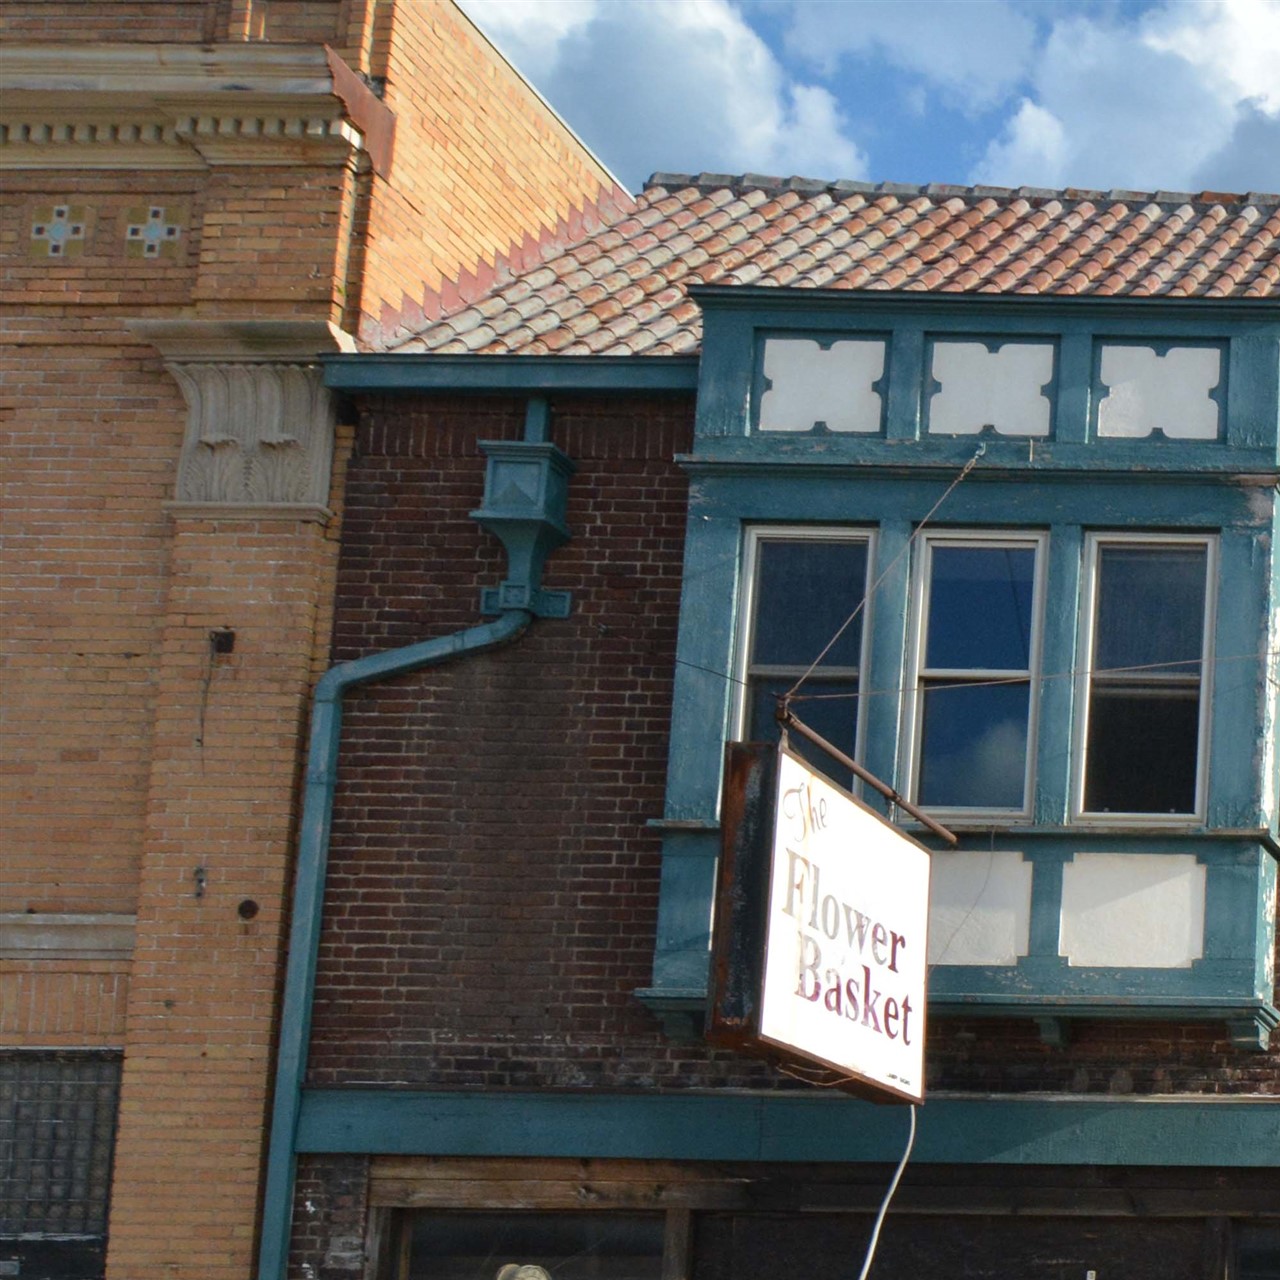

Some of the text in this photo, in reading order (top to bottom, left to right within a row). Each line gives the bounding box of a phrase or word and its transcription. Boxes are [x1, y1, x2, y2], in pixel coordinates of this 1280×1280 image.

[782, 782, 829, 843] The
[782, 847, 907, 974] Flower
[793, 929, 913, 1047] Basket
